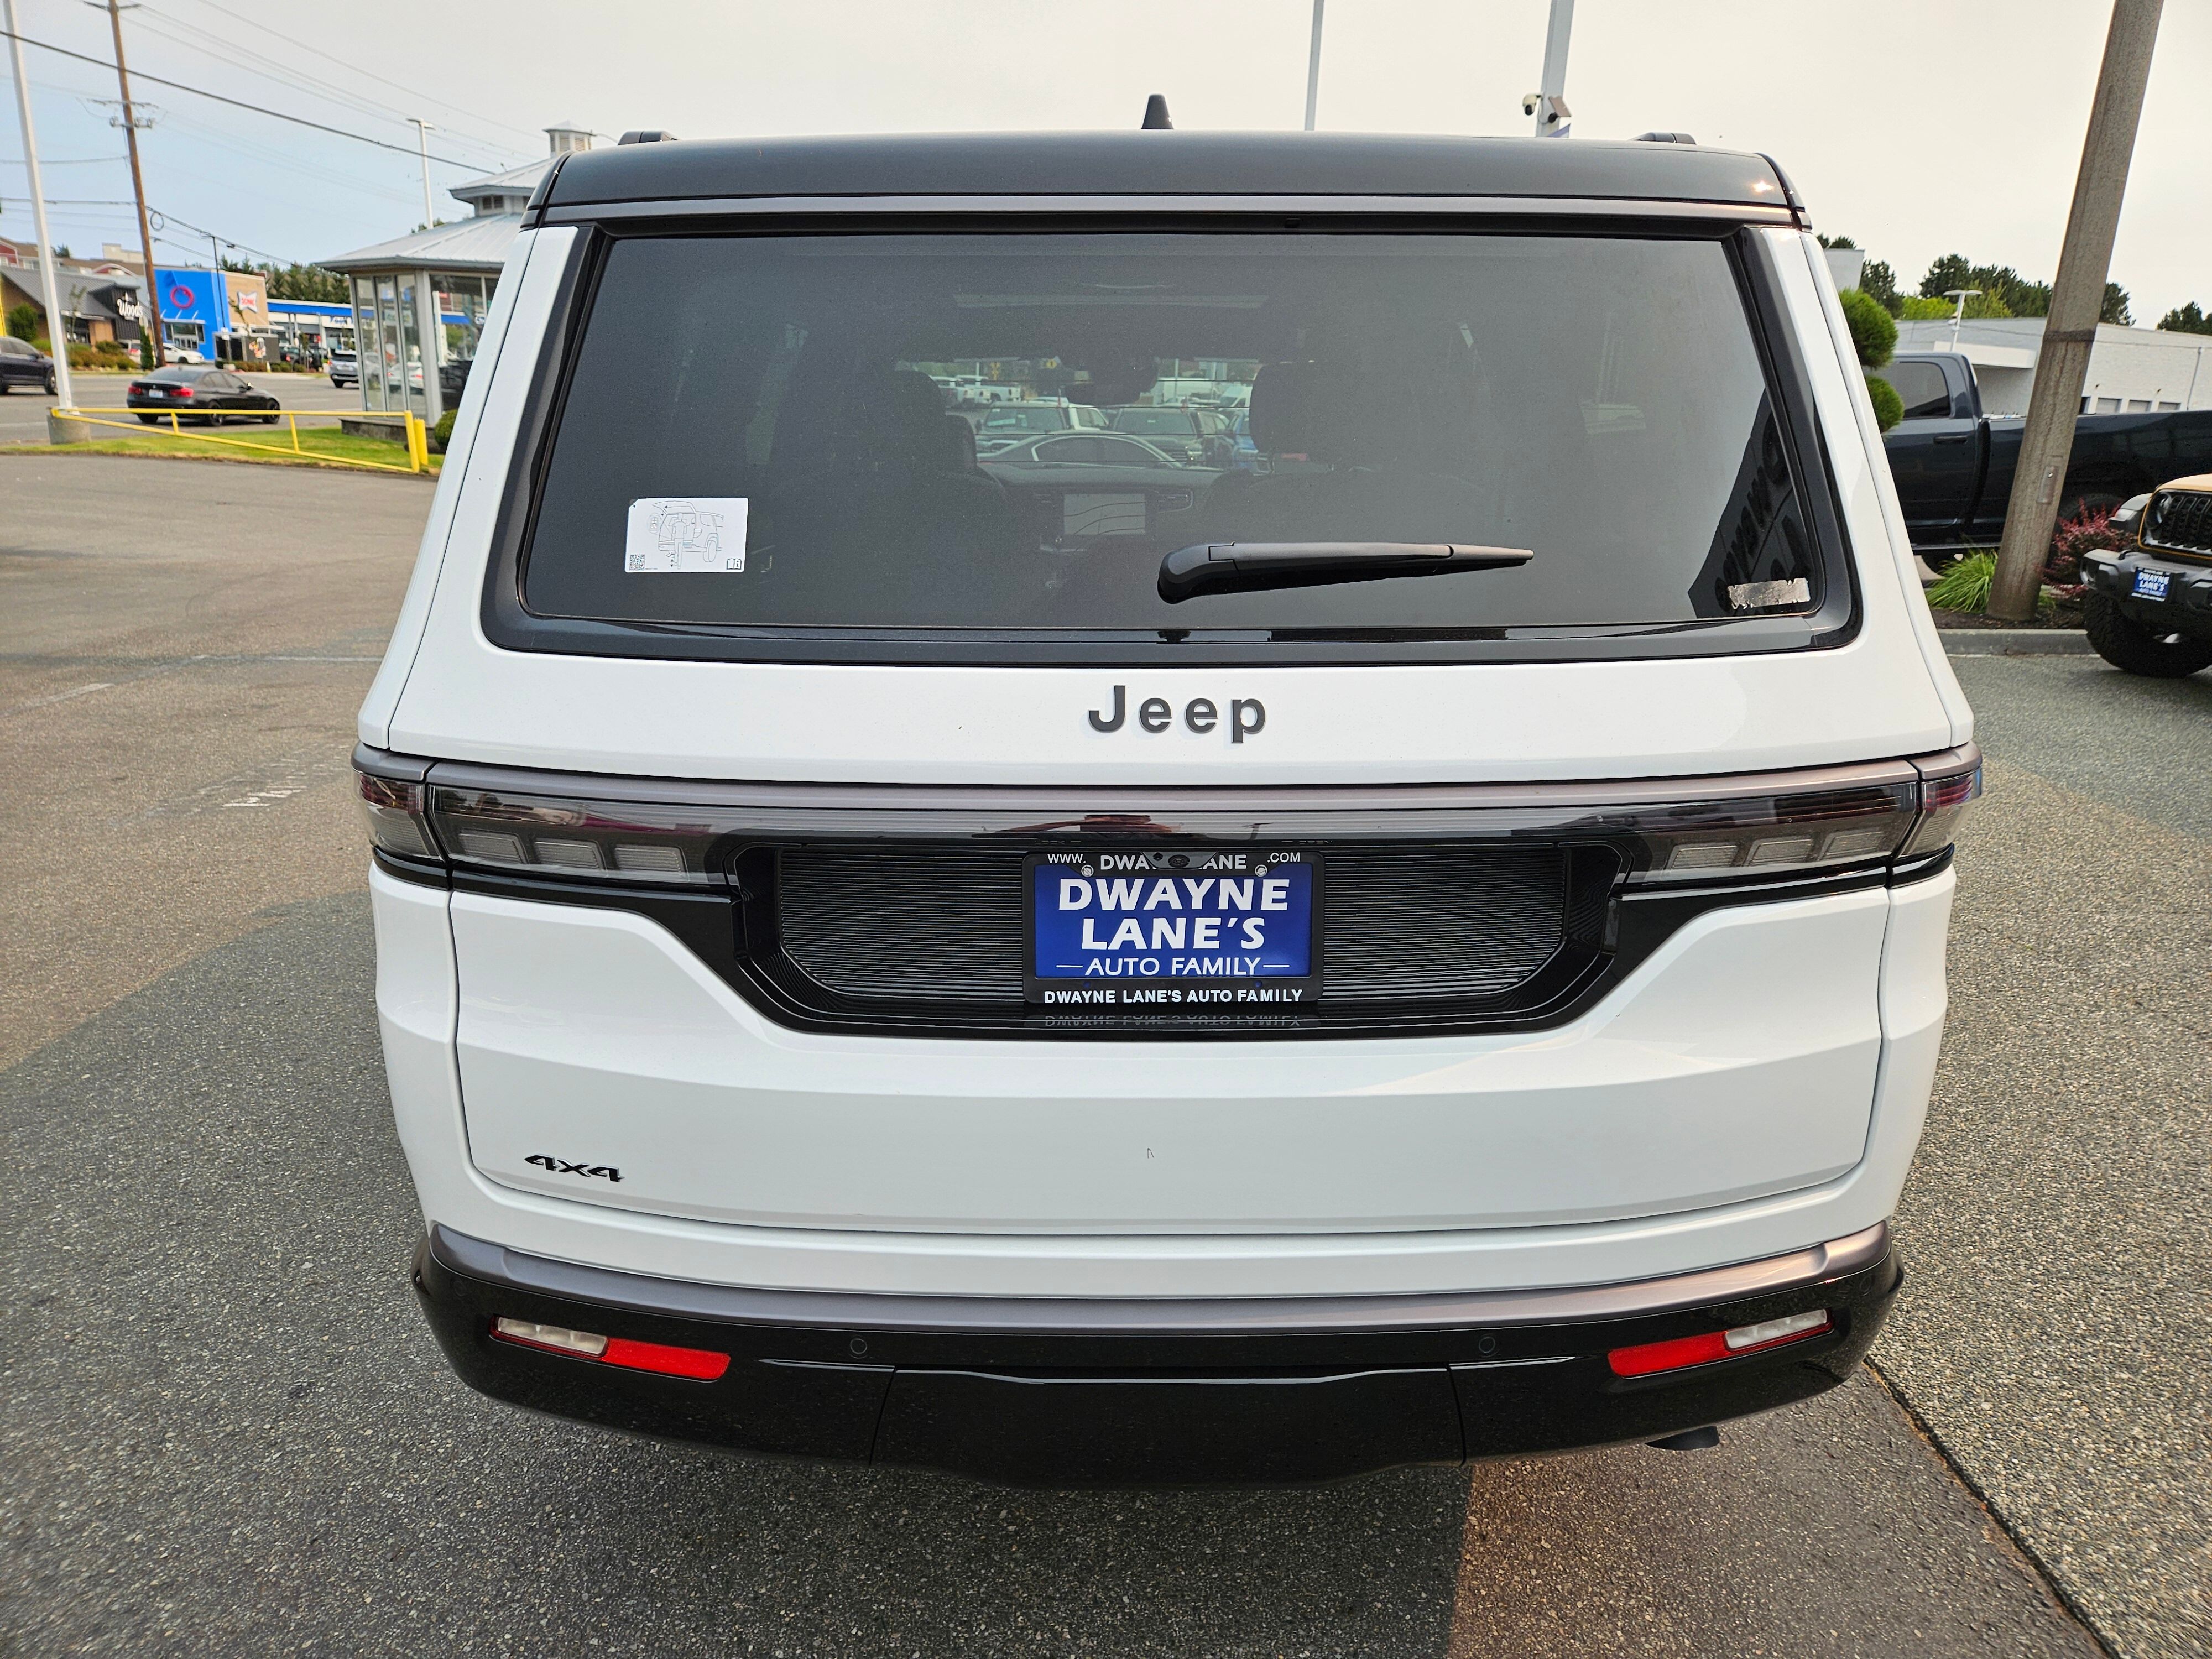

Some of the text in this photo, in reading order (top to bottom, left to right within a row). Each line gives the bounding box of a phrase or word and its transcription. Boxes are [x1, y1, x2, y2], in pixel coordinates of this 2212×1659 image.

[117, 298, 143, 317] Woods
[2138, 572, 2169, 585] DWAYNE
[1088, 685, 1266, 744] Jeep
[1047, 853, 1086, 864] WWW.
[1267, 852, 1300, 863] .COM
[1059, 878, 1290, 910] DWAYNE
[1082, 917, 1265, 950] LANE'S
[1085, 957, 1261, 975] AUTO FAMILY
[1044, 989, 1303, 1003] DWAYNE LANE'S AUTO FAMILY
[524, 1153, 625, 1182] 4x4
